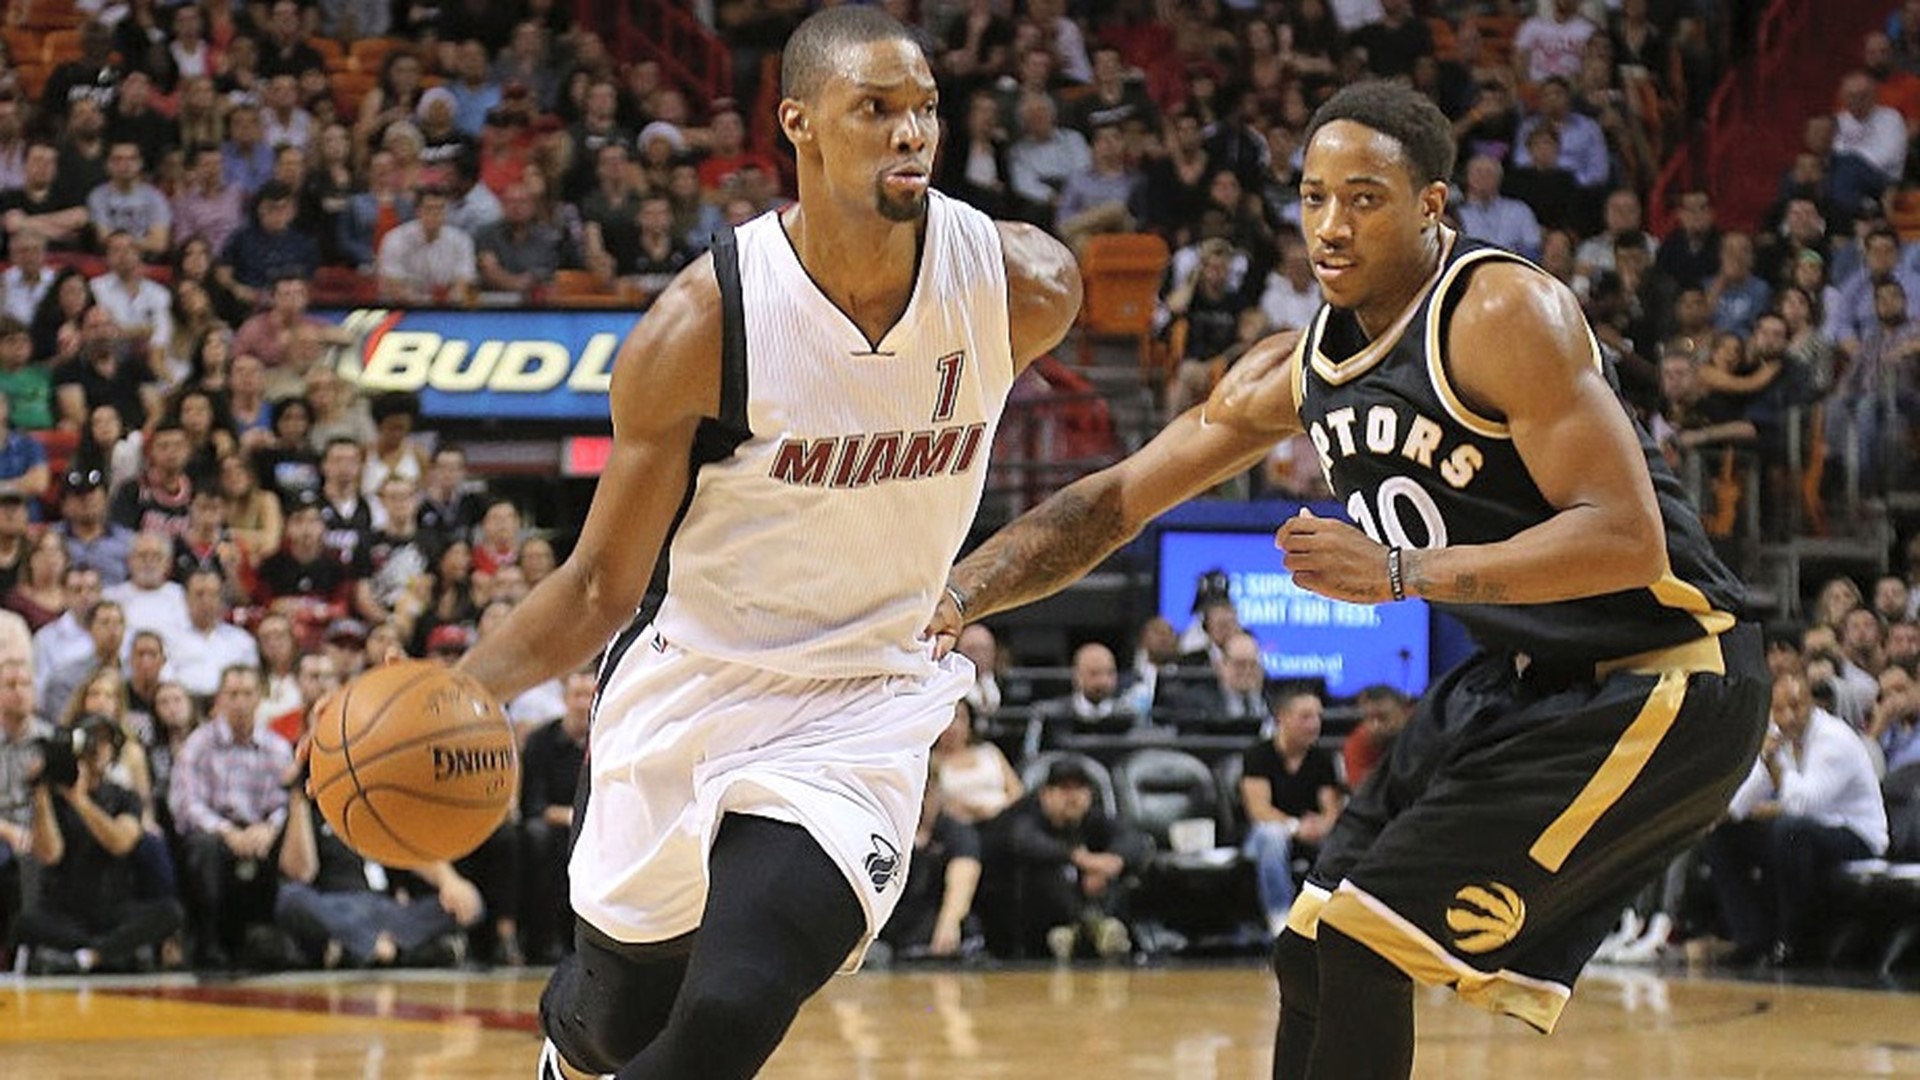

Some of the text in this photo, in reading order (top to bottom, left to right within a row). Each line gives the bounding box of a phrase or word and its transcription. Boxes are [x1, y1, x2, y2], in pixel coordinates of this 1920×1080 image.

[361, 331, 571, 391] BUD
[932, 350, 965, 423] 1
[769, 422, 986, 489] MIAMI
[1347, 476, 1448, 551] 10
